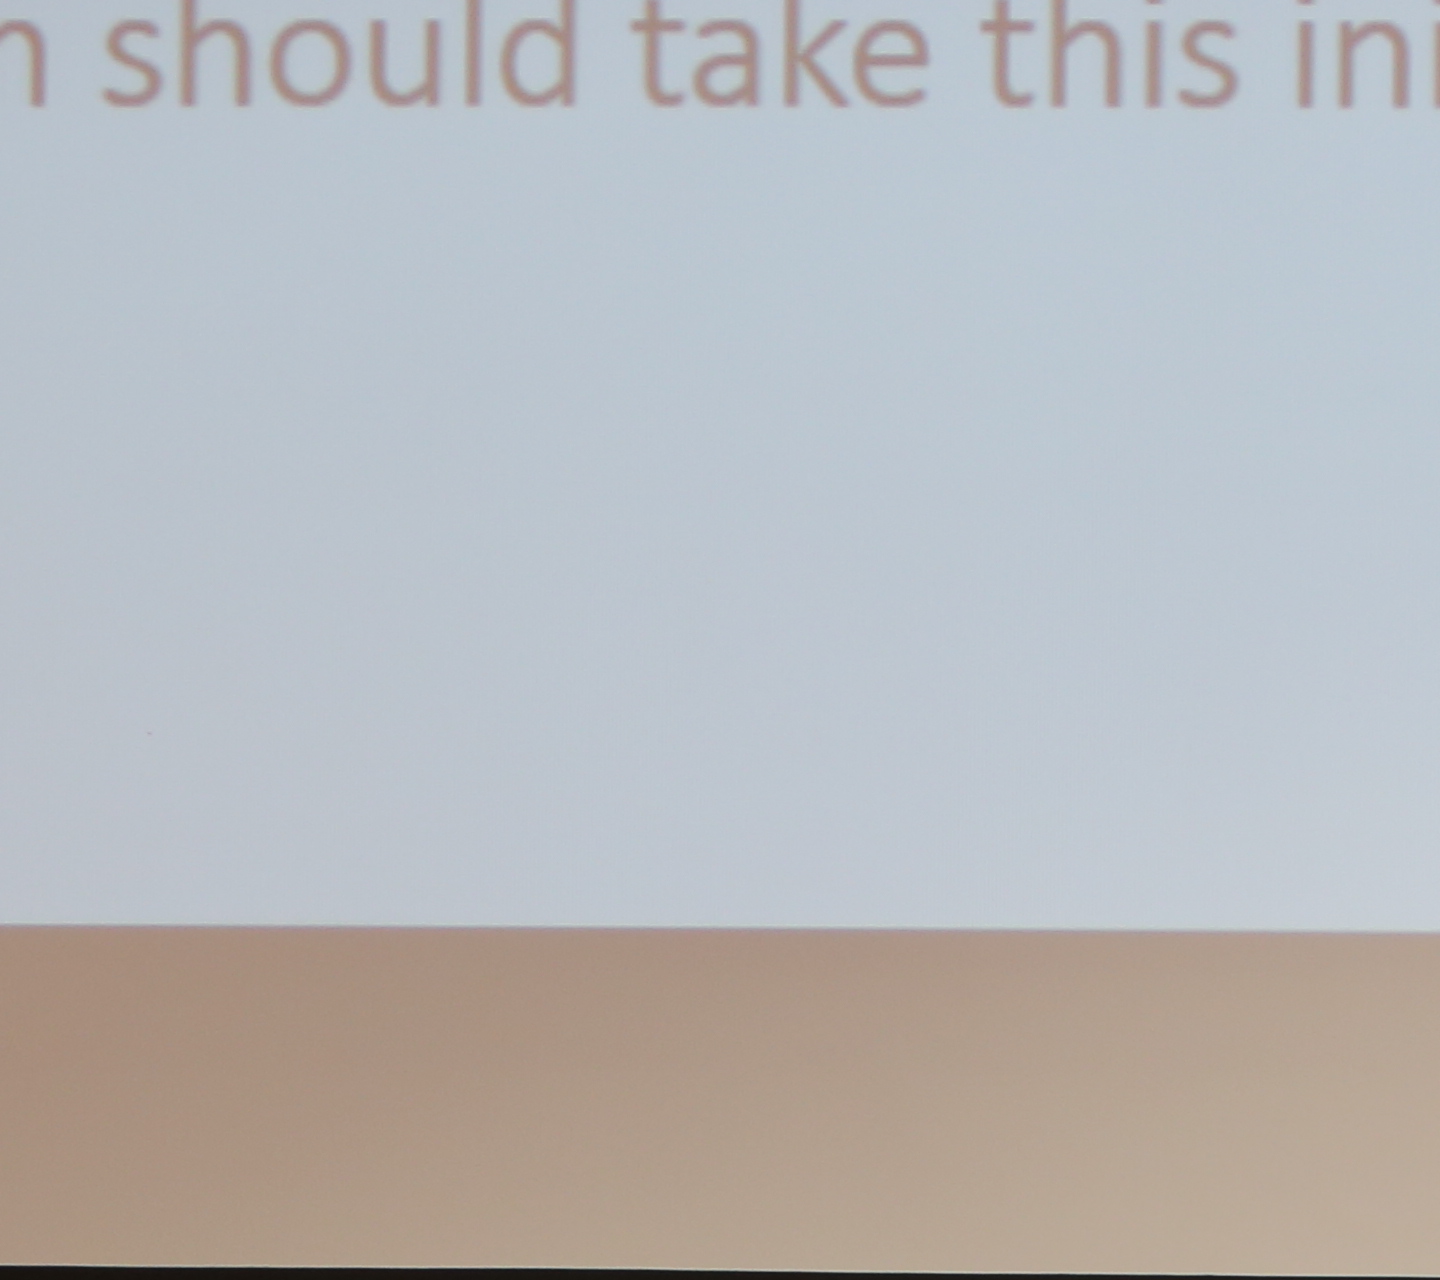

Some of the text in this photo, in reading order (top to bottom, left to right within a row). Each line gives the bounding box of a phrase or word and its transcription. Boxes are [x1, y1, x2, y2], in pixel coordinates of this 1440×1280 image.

[100, 0, 578, 109] should
[630, 0, 931, 109] take
[979, 0, 1241, 110] this
